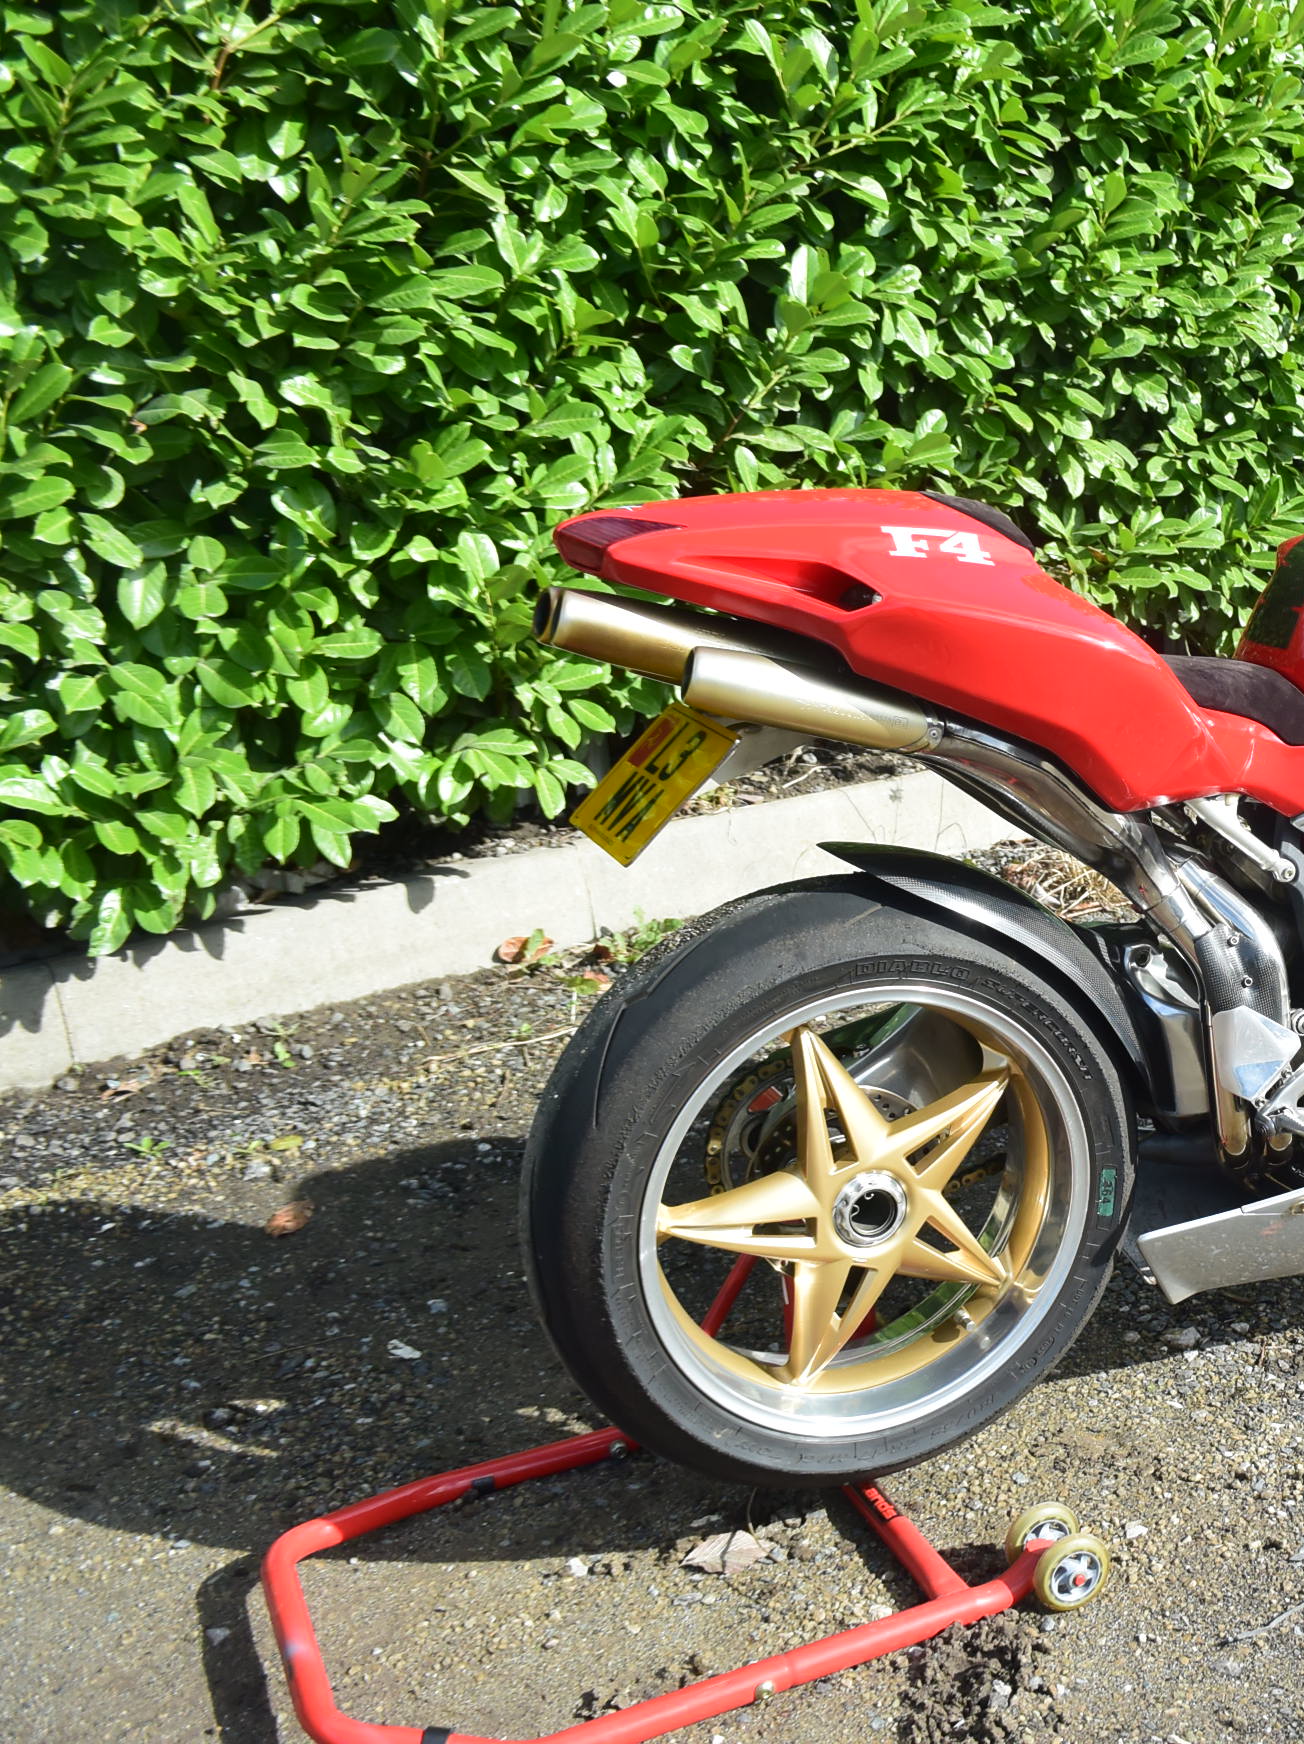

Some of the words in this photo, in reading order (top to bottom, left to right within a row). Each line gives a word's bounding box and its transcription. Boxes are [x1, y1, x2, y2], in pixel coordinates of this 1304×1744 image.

[880, 525, 995, 566] F4
[645, 721, 707, 781] L3
[593, 770, 665, 843] MVA
[855, 960, 971, 981] DIABLO
